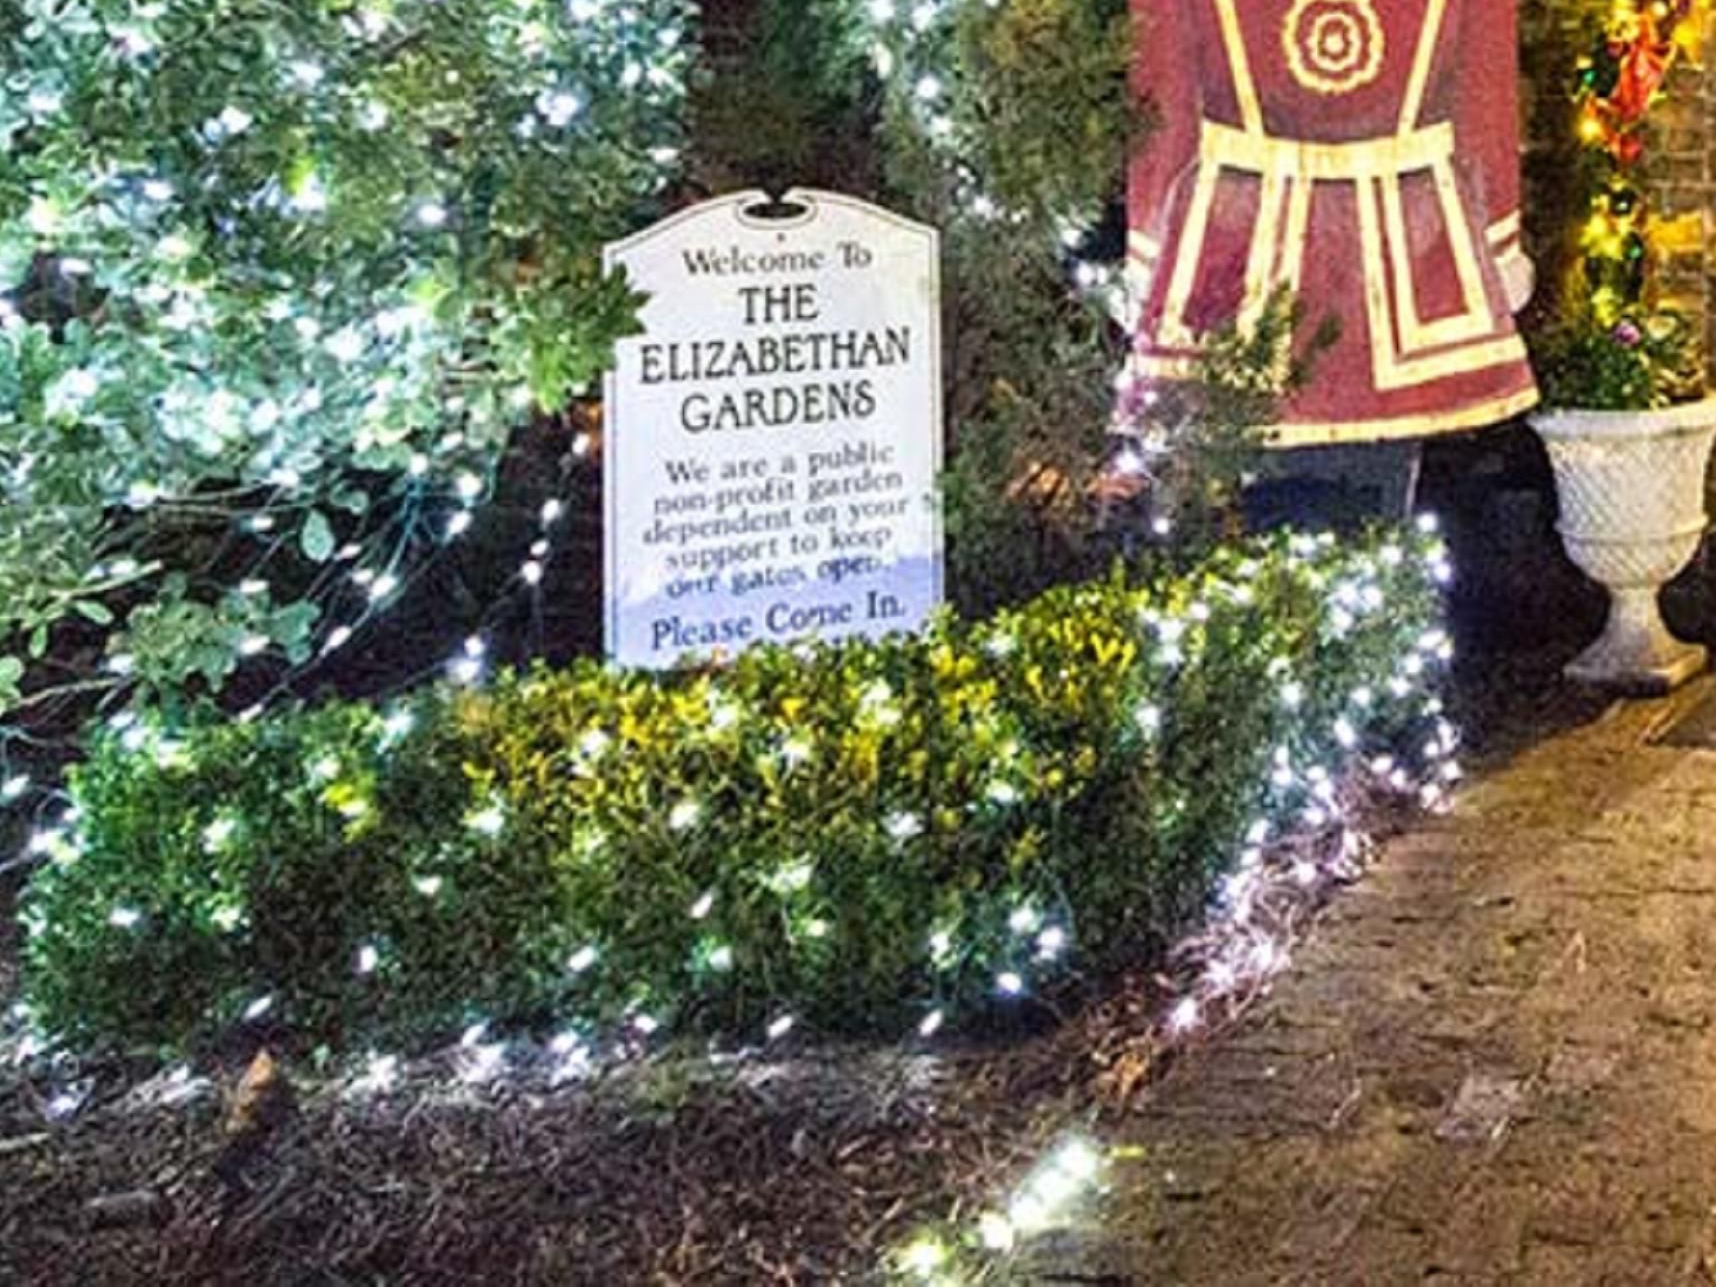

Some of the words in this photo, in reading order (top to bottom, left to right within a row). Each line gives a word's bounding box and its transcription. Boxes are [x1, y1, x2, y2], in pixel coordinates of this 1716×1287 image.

[682, 246, 824, 276] Welcome
[837, 242, 872, 268] To
[738, 284, 819, 325] THE
[640, 327, 910, 384] ELIZABETHAN
[681, 380, 876, 433] GARDENS
[665, 460, 709, 484] We
[720, 458, 768, 479] are
[780, 457, 796, 473] a
[809, 442, 894, 475] public
[654, 477, 795, 514] non-profit
[808, 468, 903, 502] garden
[643, 510, 792, 545] dependent
[804, 506, 836, 524] on
[849, 498, 909, 526] your
[666, 536, 779, 570] support
[791, 532, 818, 553] to
[830, 526, 891, 550] keep
[732, 565, 807, 595] gates
[652, 616, 752, 650] Please
[766, 602, 852, 633] Come
[867, 591, 905, 619] In.
